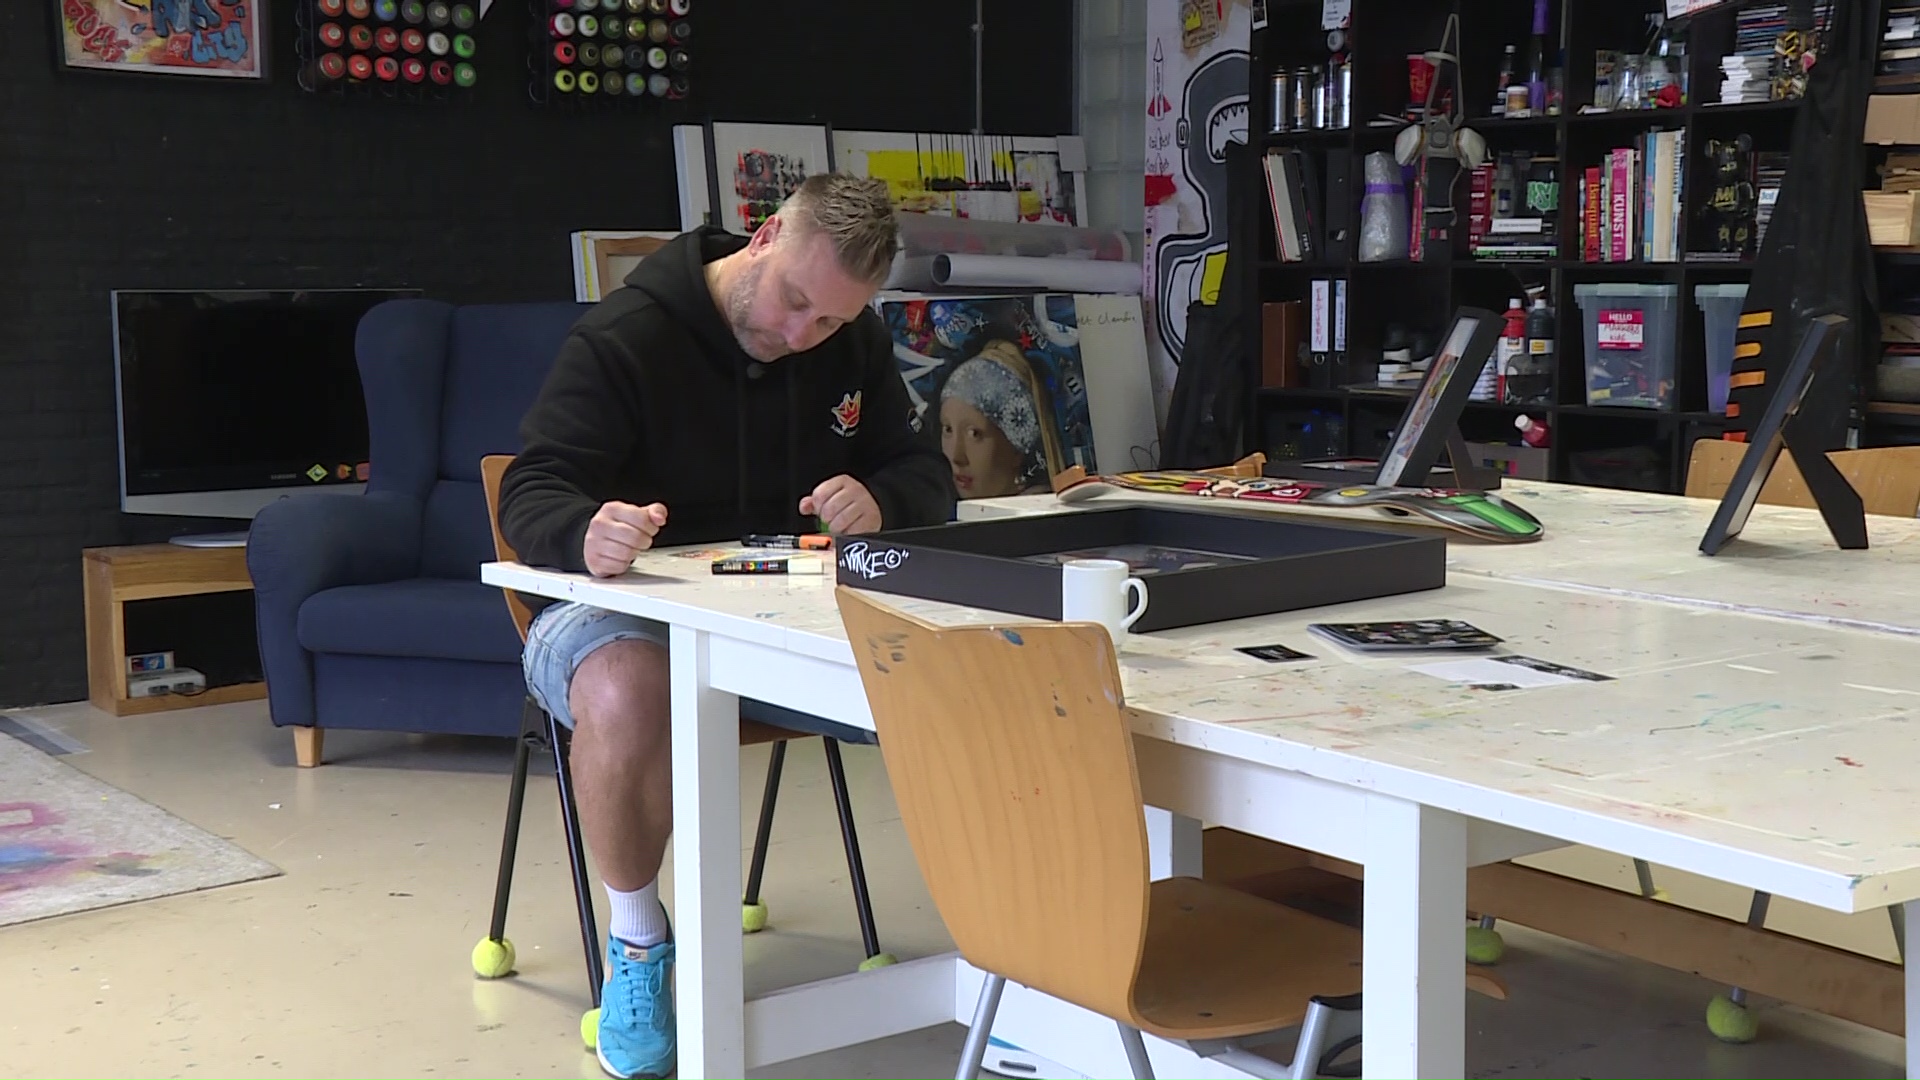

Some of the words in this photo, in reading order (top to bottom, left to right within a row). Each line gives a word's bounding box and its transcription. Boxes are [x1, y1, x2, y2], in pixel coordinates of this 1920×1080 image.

[1585, 183, 1600, 238] Basquiat
[1612, 193, 1626, 239] KUNST
[1608, 313, 1633, 321] HELLO
